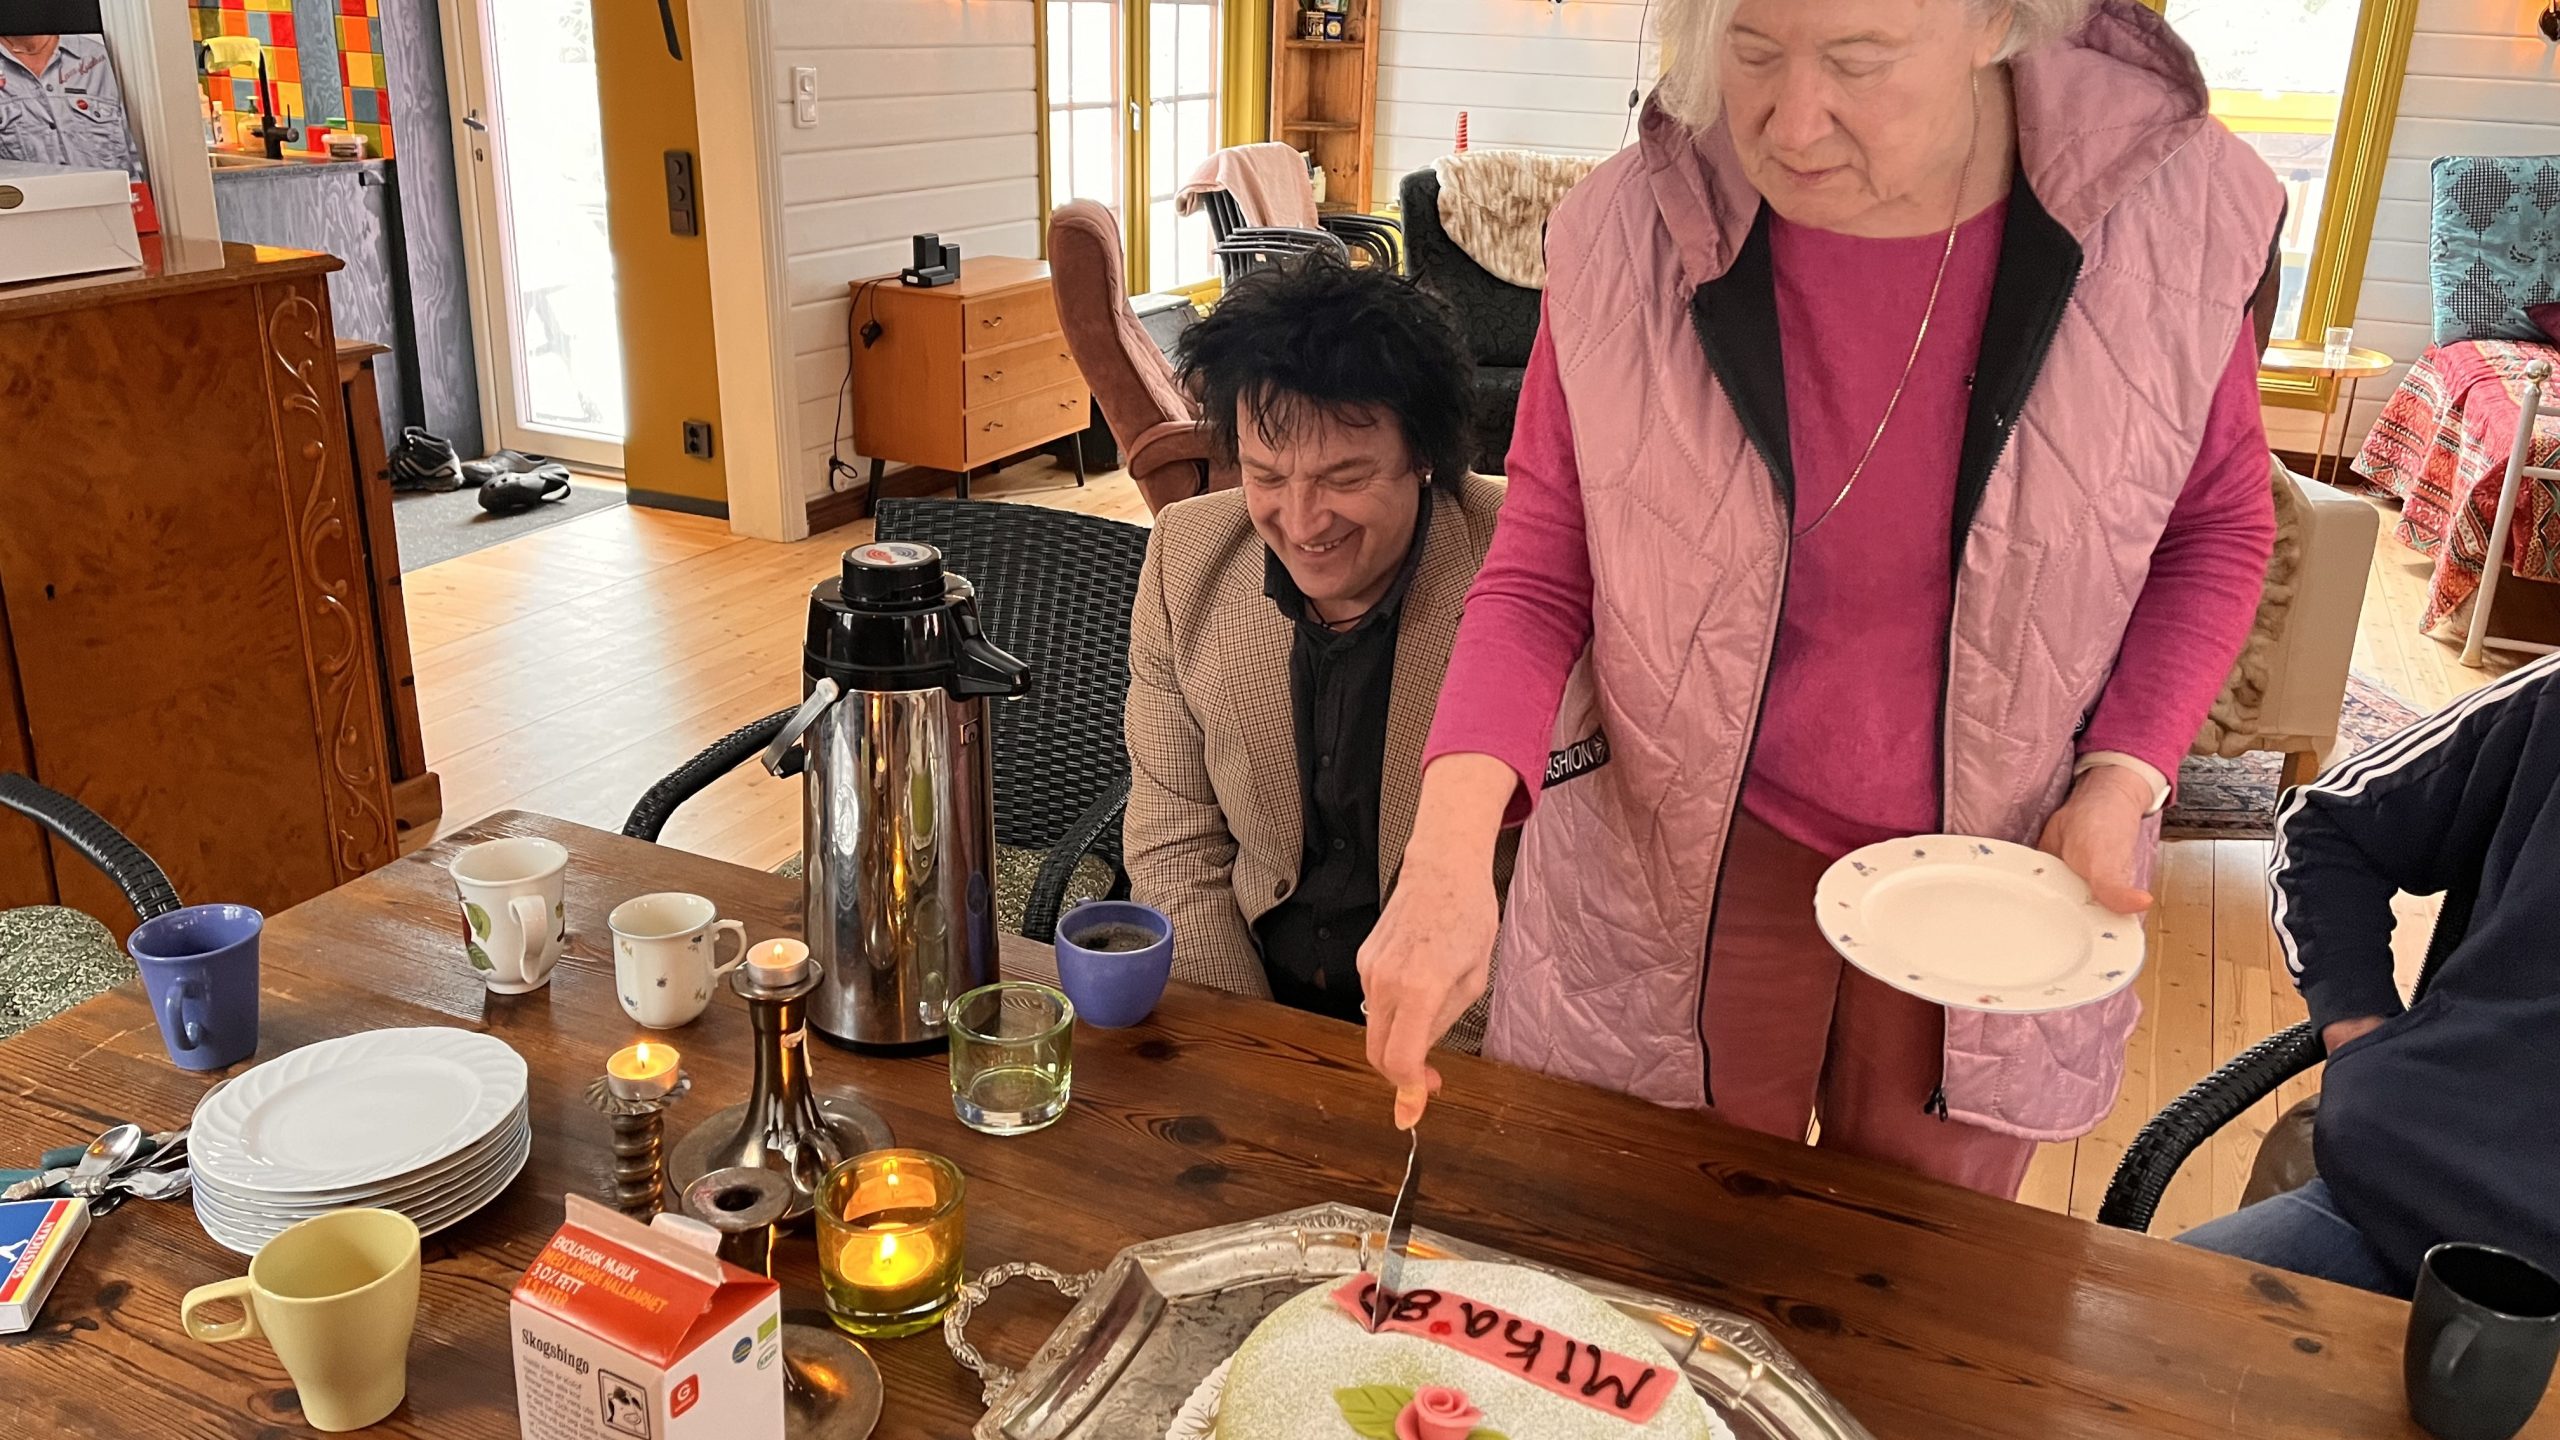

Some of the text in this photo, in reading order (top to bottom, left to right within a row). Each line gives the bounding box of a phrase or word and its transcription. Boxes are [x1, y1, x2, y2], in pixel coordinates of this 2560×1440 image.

[1545, 742, 1594, 781] ASHION
[12, 1221, 57, 1278] SOLSTICKAN
[539, 1250, 567, 1269] MED
[551, 1235, 606, 1268] EKOLOGISK
[556, 1271, 587, 1295] FETT
[521, 1328, 590, 1375] Skogsbingo
